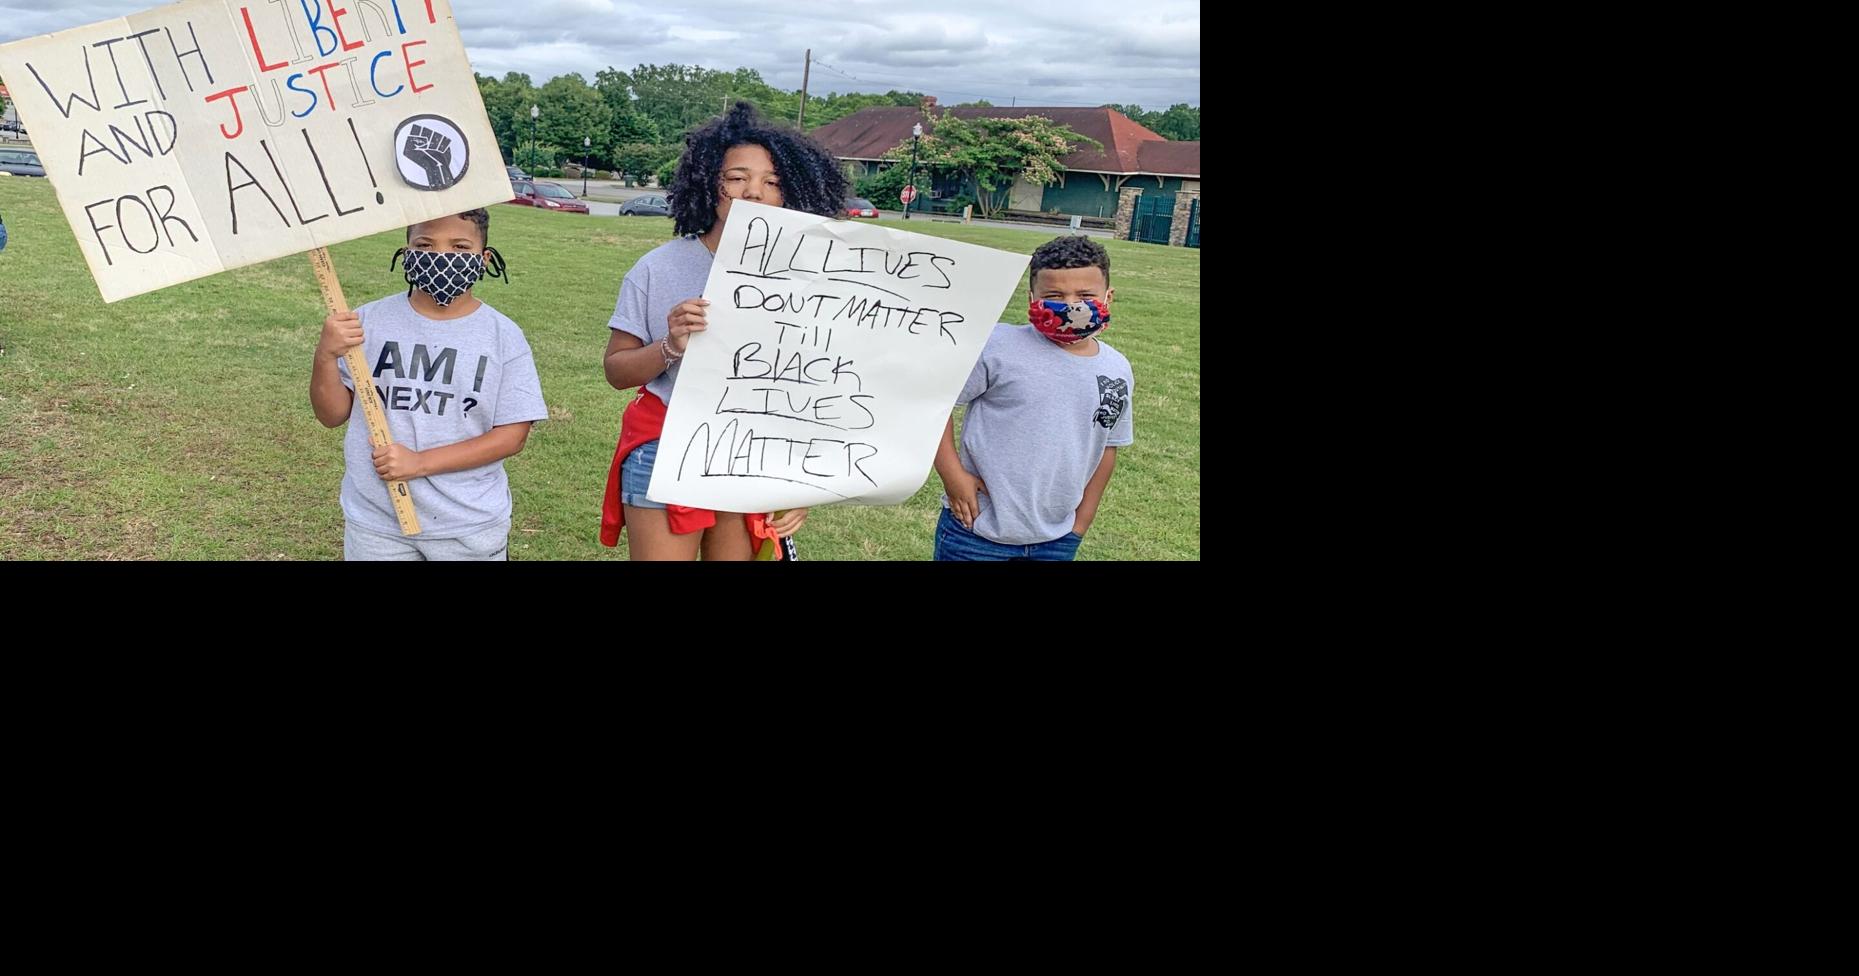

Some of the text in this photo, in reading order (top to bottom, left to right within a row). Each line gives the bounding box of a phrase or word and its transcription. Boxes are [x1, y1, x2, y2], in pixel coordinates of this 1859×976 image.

[25, 21, 214, 119] WITH
[78, 40, 434, 176] AND JUSTICE
[84, 118, 385, 266] FOR ALL!
[740, 217, 955, 290] ALL LIVES
[832, 295, 965, 345] MATTER
[372, 341, 488, 393] AM I
[375, 385, 454, 416] NEXT
[716, 387, 875, 430] LIVES
[678, 418, 878, 487] MATTER
